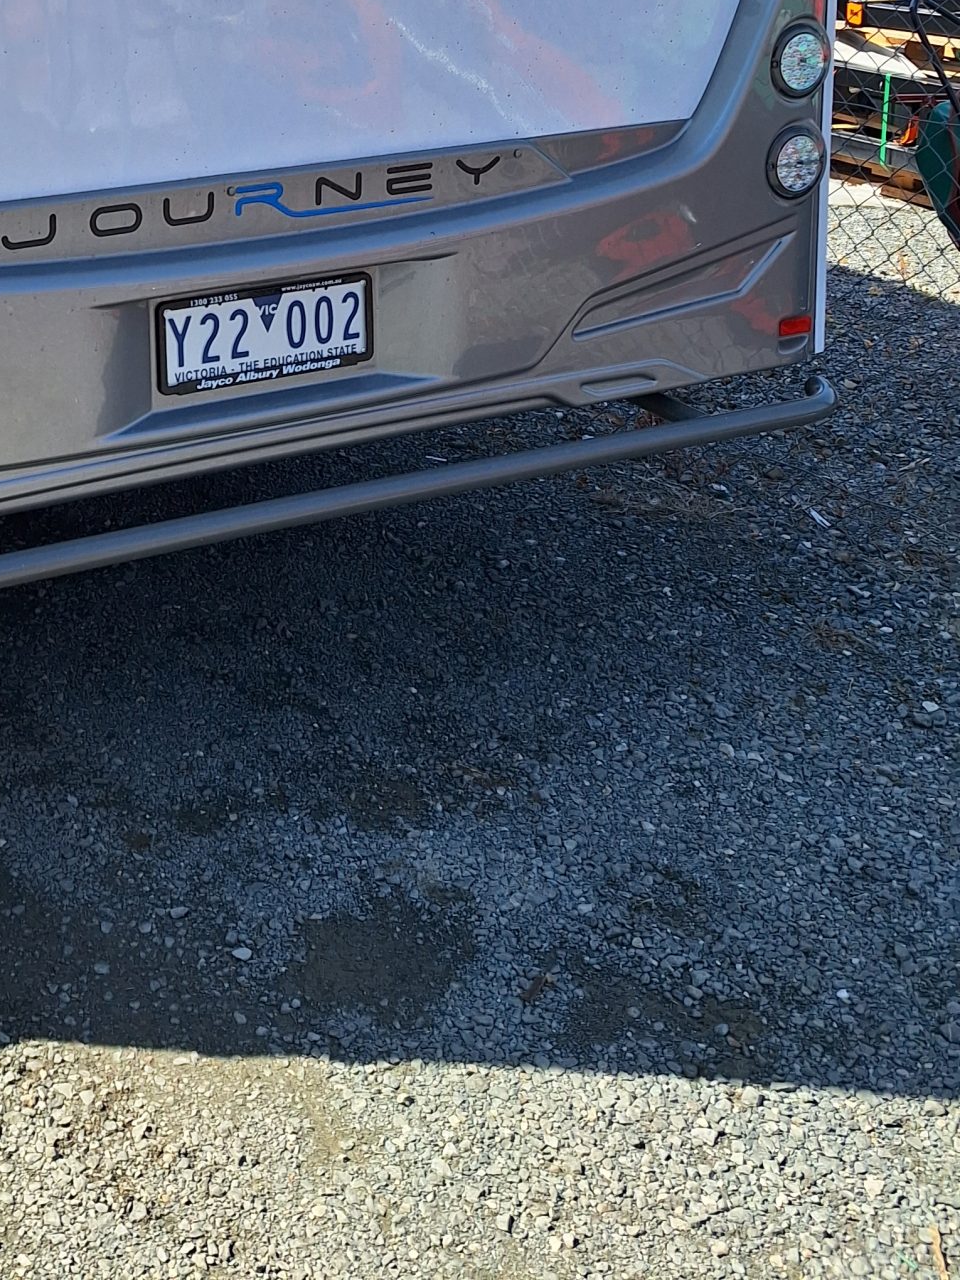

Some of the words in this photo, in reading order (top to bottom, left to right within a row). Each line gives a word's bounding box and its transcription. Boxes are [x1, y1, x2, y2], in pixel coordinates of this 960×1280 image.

[1, 155, 500, 251] JOURNEY
[190, 297, 208, 307] 1300
[209, 295, 223, 304] 233
[224, 292, 238, 302] 055
[256, 303, 277, 317] VIC
[167, 308, 250, 368] Y22
[286, 291, 360, 349] 002
[174, 365, 227, 383] VICTORIA
[239, 359, 260, 372] THE
[263, 350, 325, 369] EDUCATION
[326, 343, 358, 358] STATE
[196, 375, 232, 390] Jayco
[236, 368, 279, 384] Albury
[281, 357, 341, 376] Wodonga
